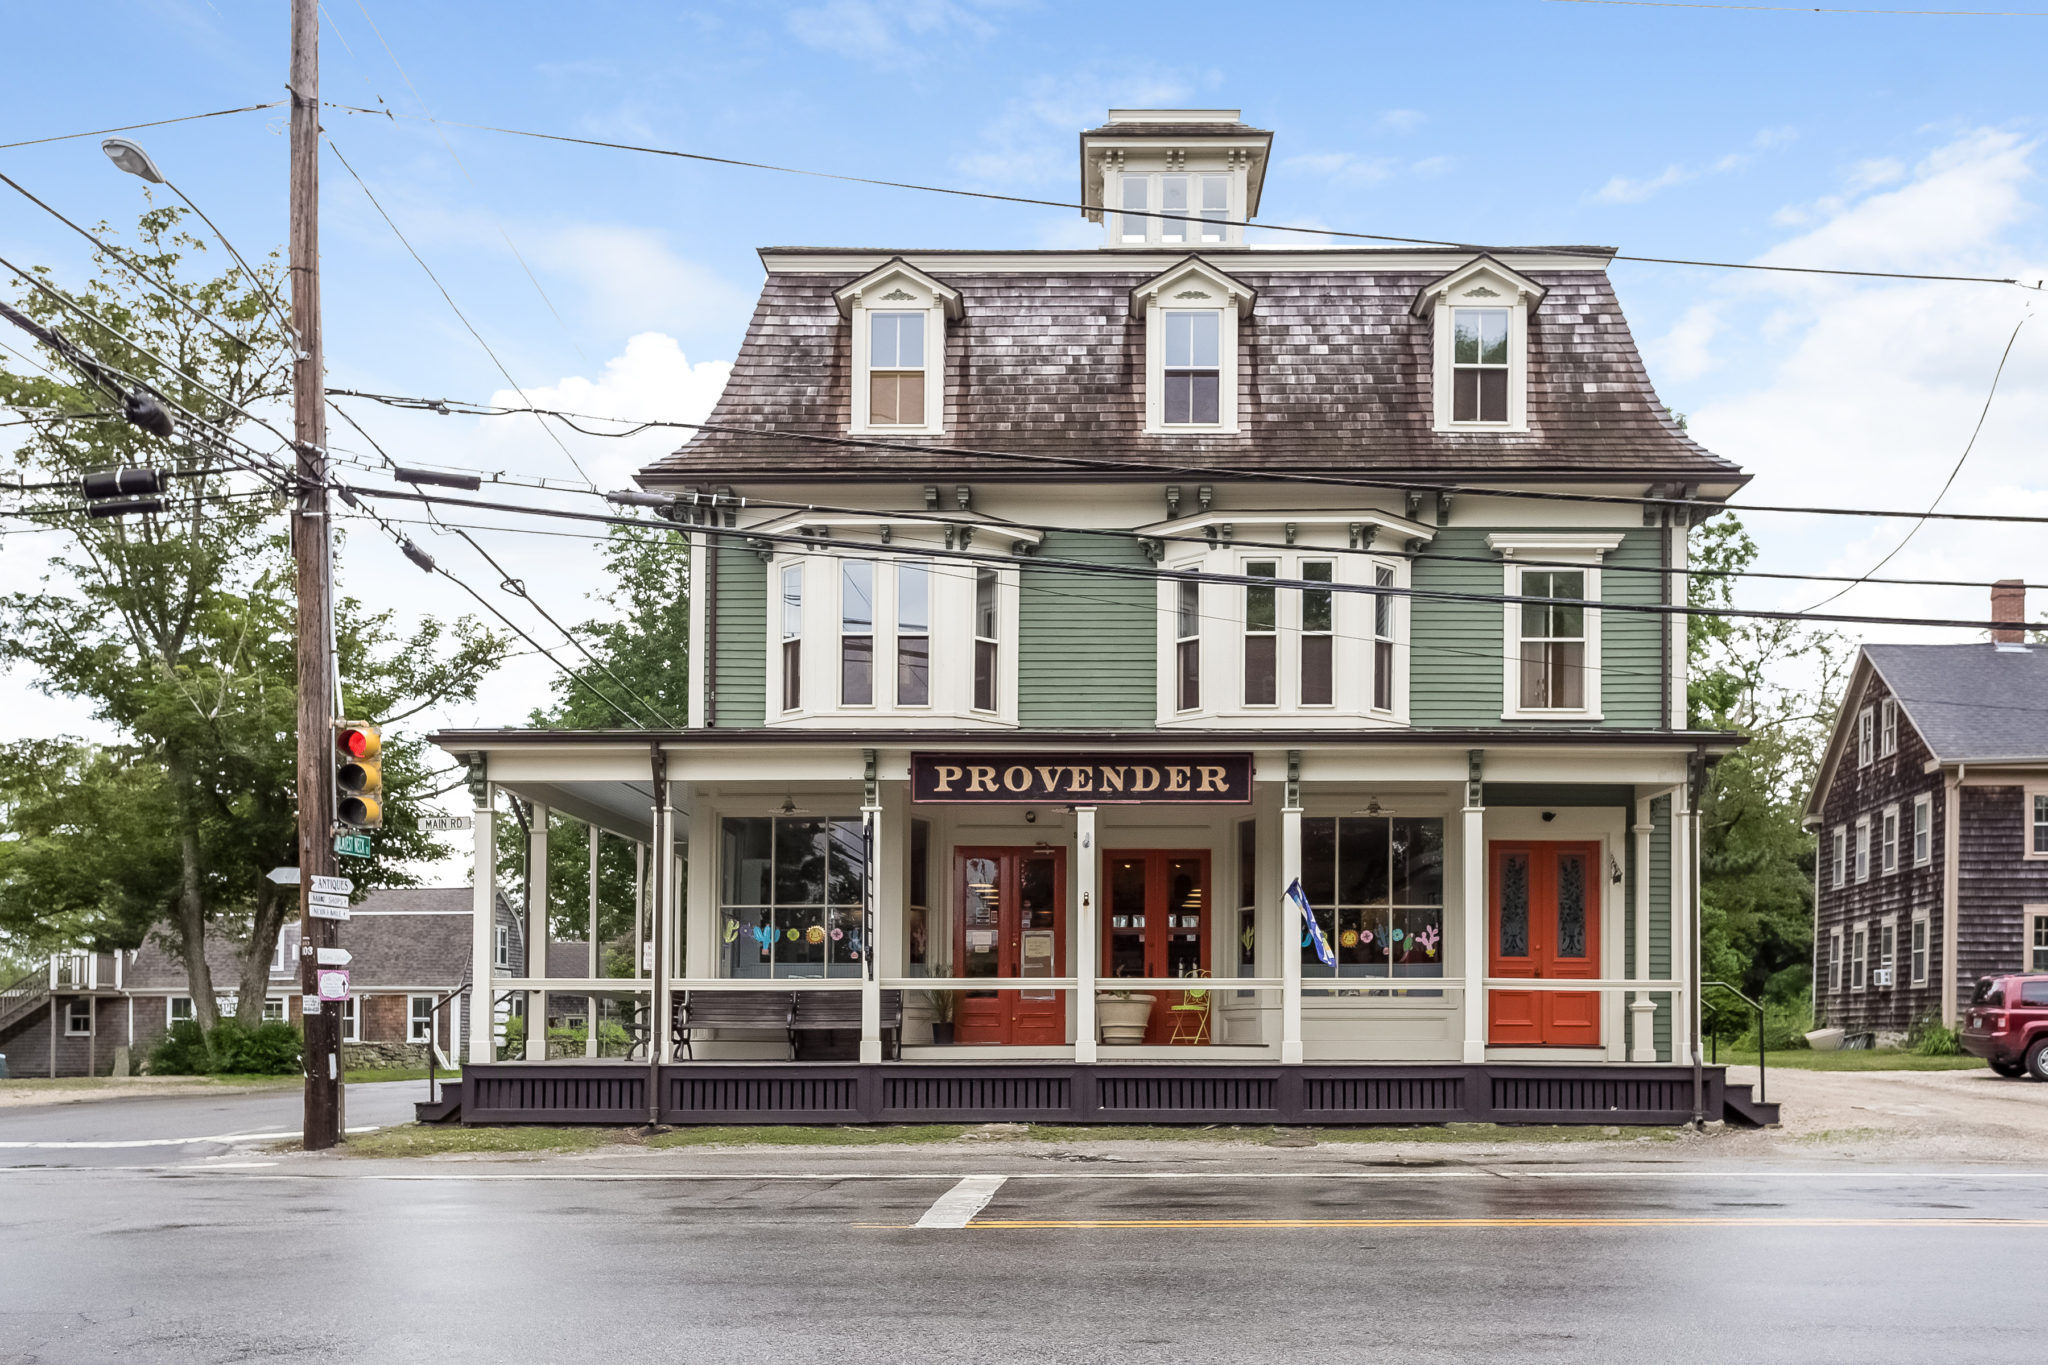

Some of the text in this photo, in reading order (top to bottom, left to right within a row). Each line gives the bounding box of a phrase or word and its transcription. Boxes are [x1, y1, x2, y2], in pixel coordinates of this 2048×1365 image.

[933, 765, 1230, 793] PROVENDER
[425, 818, 463, 829] MAIN RD
[317, 877, 349, 891] ANTIQUES
